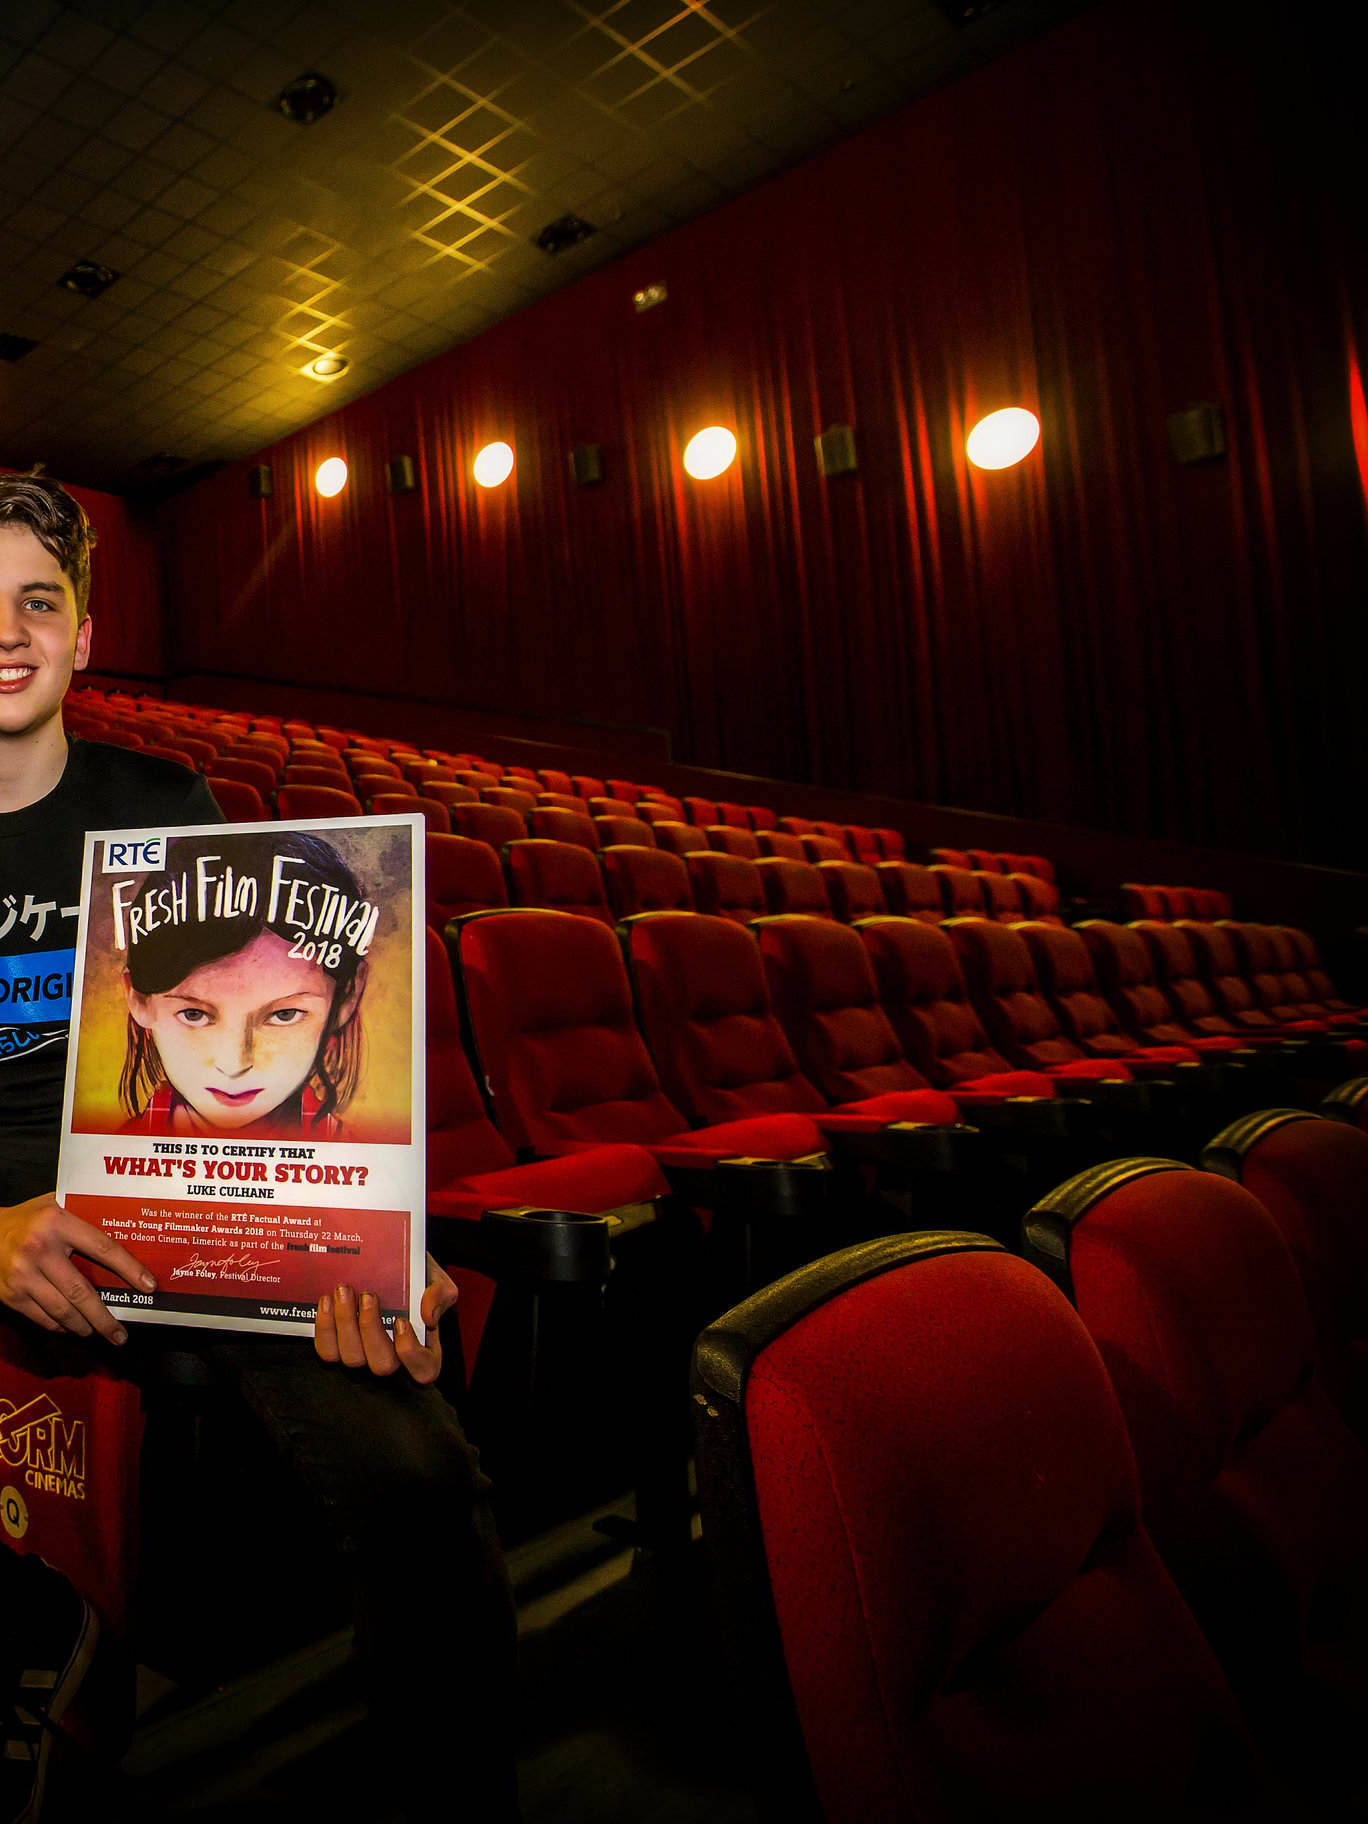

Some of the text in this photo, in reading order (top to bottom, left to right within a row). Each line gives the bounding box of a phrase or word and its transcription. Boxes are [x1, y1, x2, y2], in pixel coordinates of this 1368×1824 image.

[108, 838, 161, 867] RTÉ
[111, 871, 188, 951] FRESH
[288, 932, 343, 969] 2018
[153, 1143, 315, 1159] THIS IS TO CERTIFY THAT
[104, 1156, 369, 1186] WHAT'S YOUR STORY?
[187, 1184, 274, 1199] LUKE CULHANE
[141, 1207, 322, 1226] Was the winner of the RTÉ Factual Award at
[102, 1218, 137, 1228] Ireland's
[138, 1221, 163, 1232] Young
[165, 1222, 209, 1233] Filmmaker
[211, 1225, 243, 1235] Awards
[245, 1227, 264, 1236] 2018
[266, 1229, 277, 1237] on
[279, 1228, 319, 1240] Thursday
[321, 1230, 331, 1239] 22
[114, 1231, 129, 1240] The
[131, 1232, 156, 1242] Odeon
[157, 1234, 190, 1245] Cinema,
[192, 1236, 227, 1247] Limerick
[240, 1240, 258, 1250] part
[259, 1241, 269, 1249] of
[271, 1241, 284, 1250] the
[172, 1267, 194, 1277] Jayne
[219, 1271, 249, 1281] Festival
[250, 1273, 281, 1283] Director
[100, 1291, 154, 1305] March 2018
[25, 1470, 85, 1500] CINEMAS
[6, 1498, 20, 1528] Q
